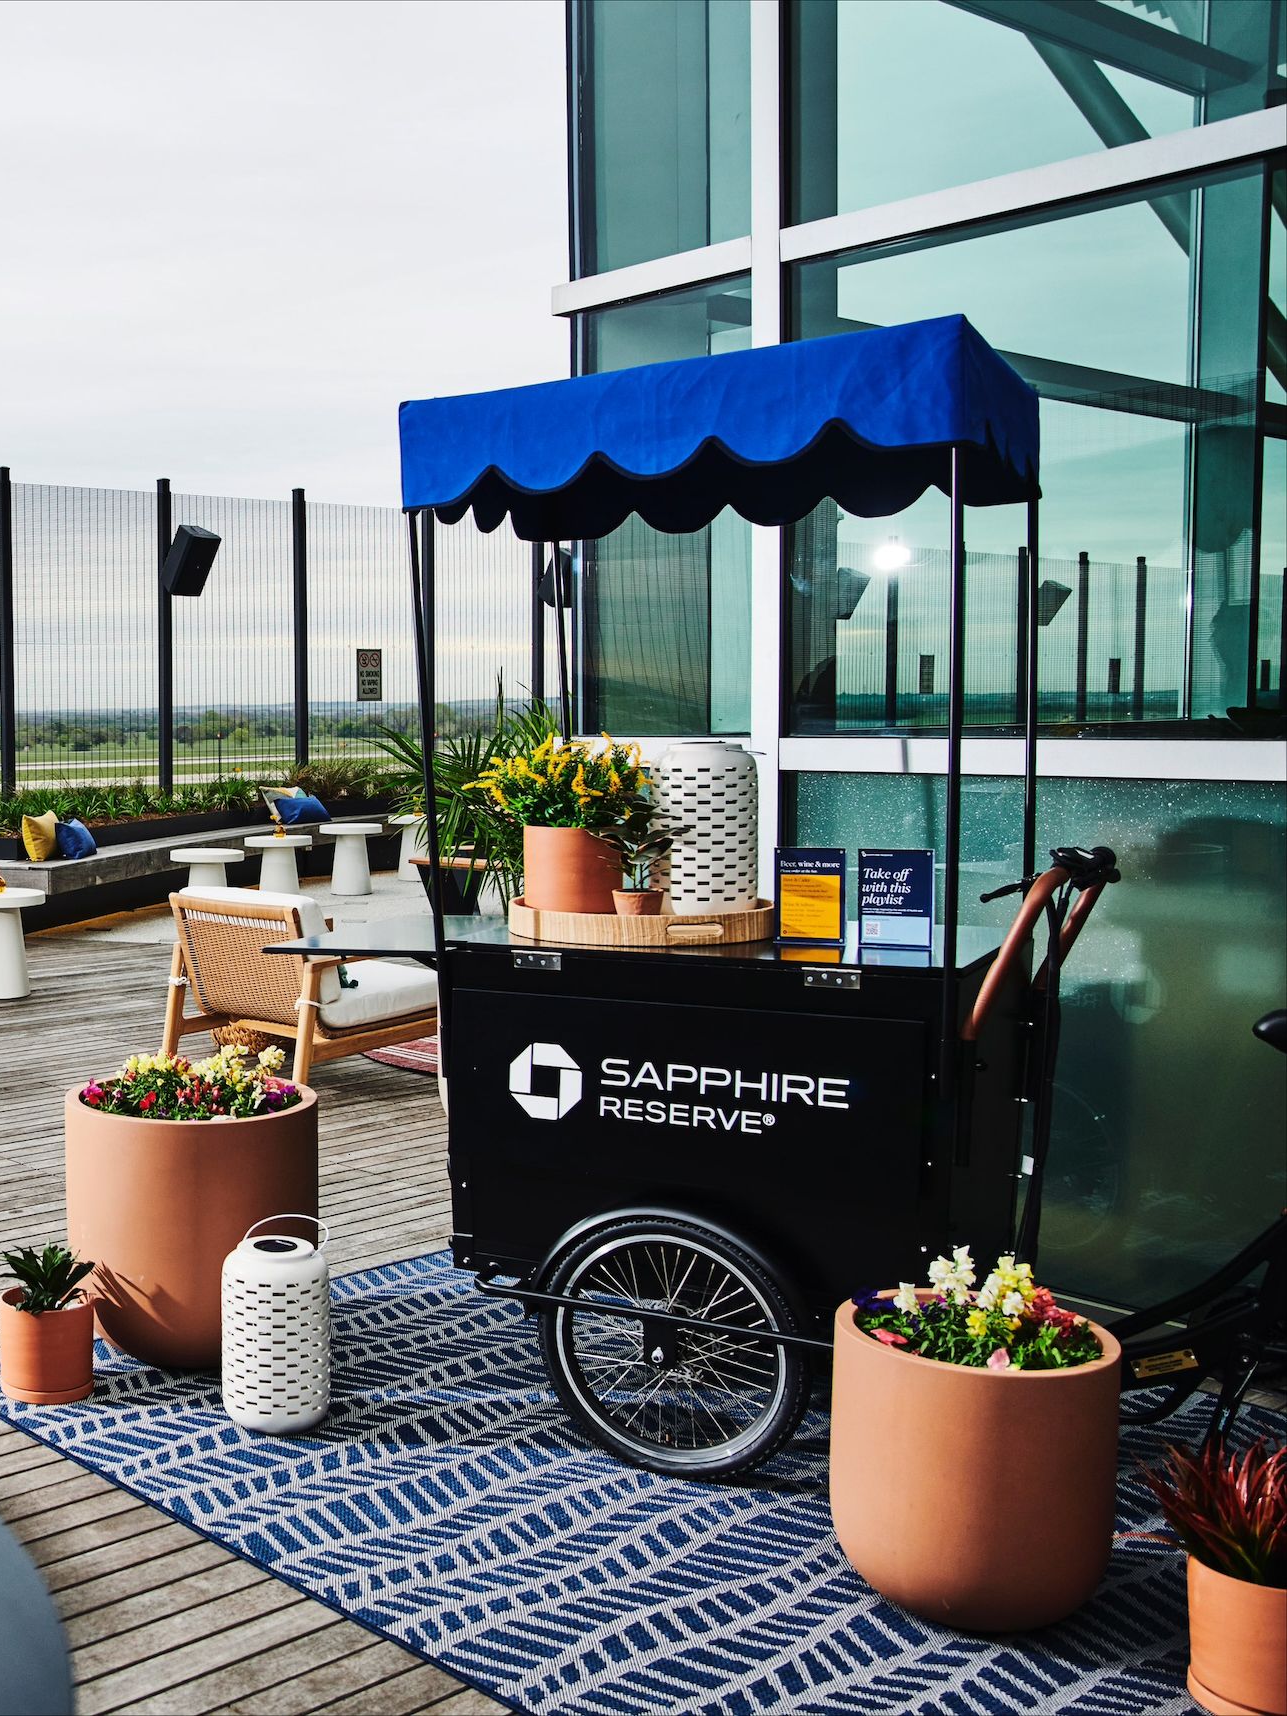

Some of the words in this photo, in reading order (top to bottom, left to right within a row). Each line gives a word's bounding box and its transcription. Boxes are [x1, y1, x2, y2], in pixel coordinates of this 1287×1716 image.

[797, 860, 814, 868] wine
[814, 860, 821, 868] &
[863, 867, 892, 879] Take
[892, 867, 913, 882] off
[861, 881, 888, 893] with
[889, 882, 912, 894] this
[861, 893, 904, 906] playlist
[600, 1057, 851, 1110] SAPPHIRE
